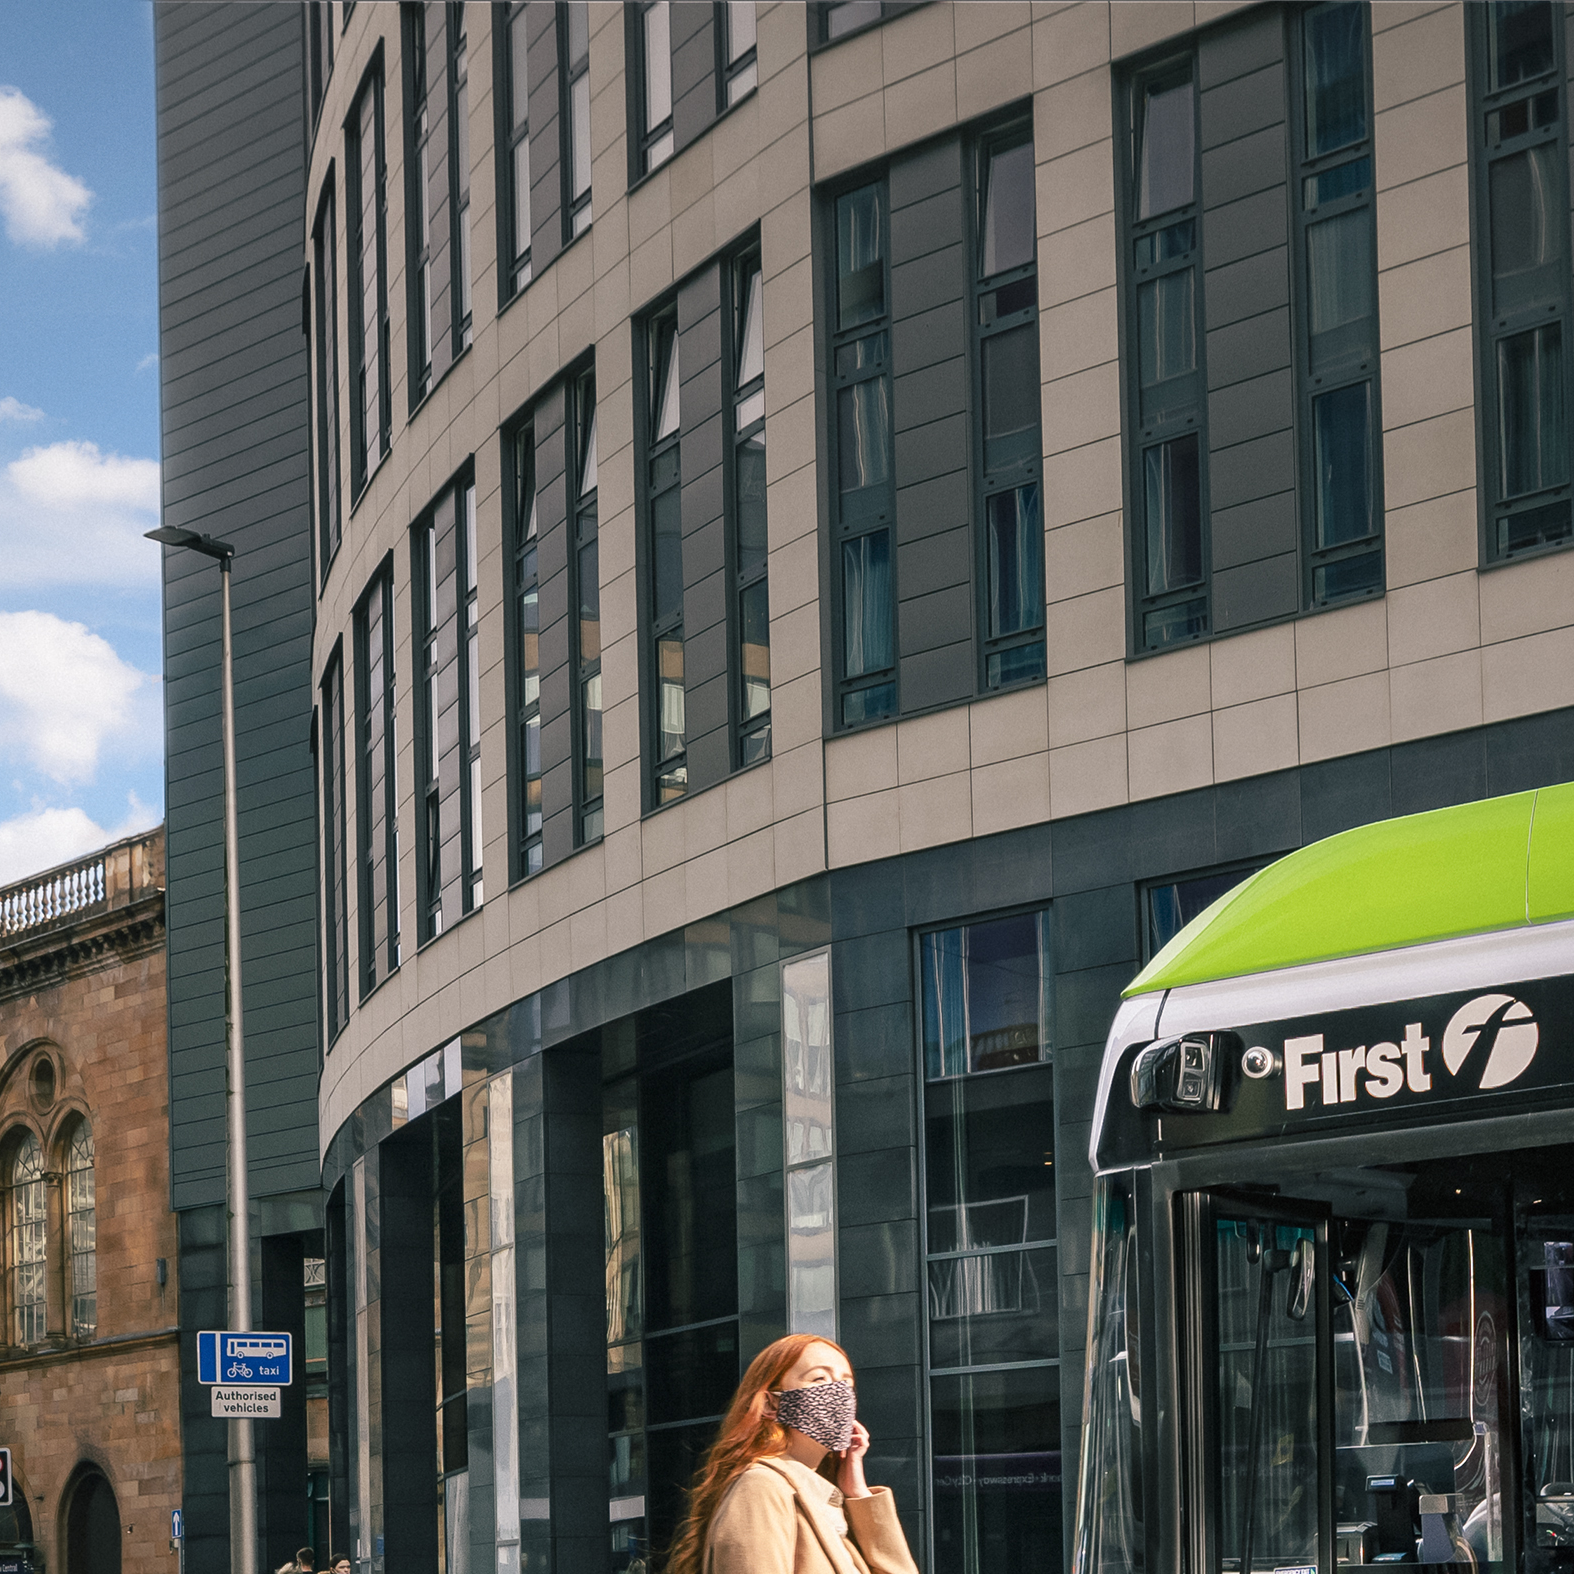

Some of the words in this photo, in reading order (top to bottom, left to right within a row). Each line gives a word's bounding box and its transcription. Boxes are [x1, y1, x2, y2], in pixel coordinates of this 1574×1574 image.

[1284, 1033, 1432, 1110] First
[259, 1366, 279, 1375] taxi
[215, 1391, 276, 1401] Authorised
[223, 1403, 268, 1412] vehicles
